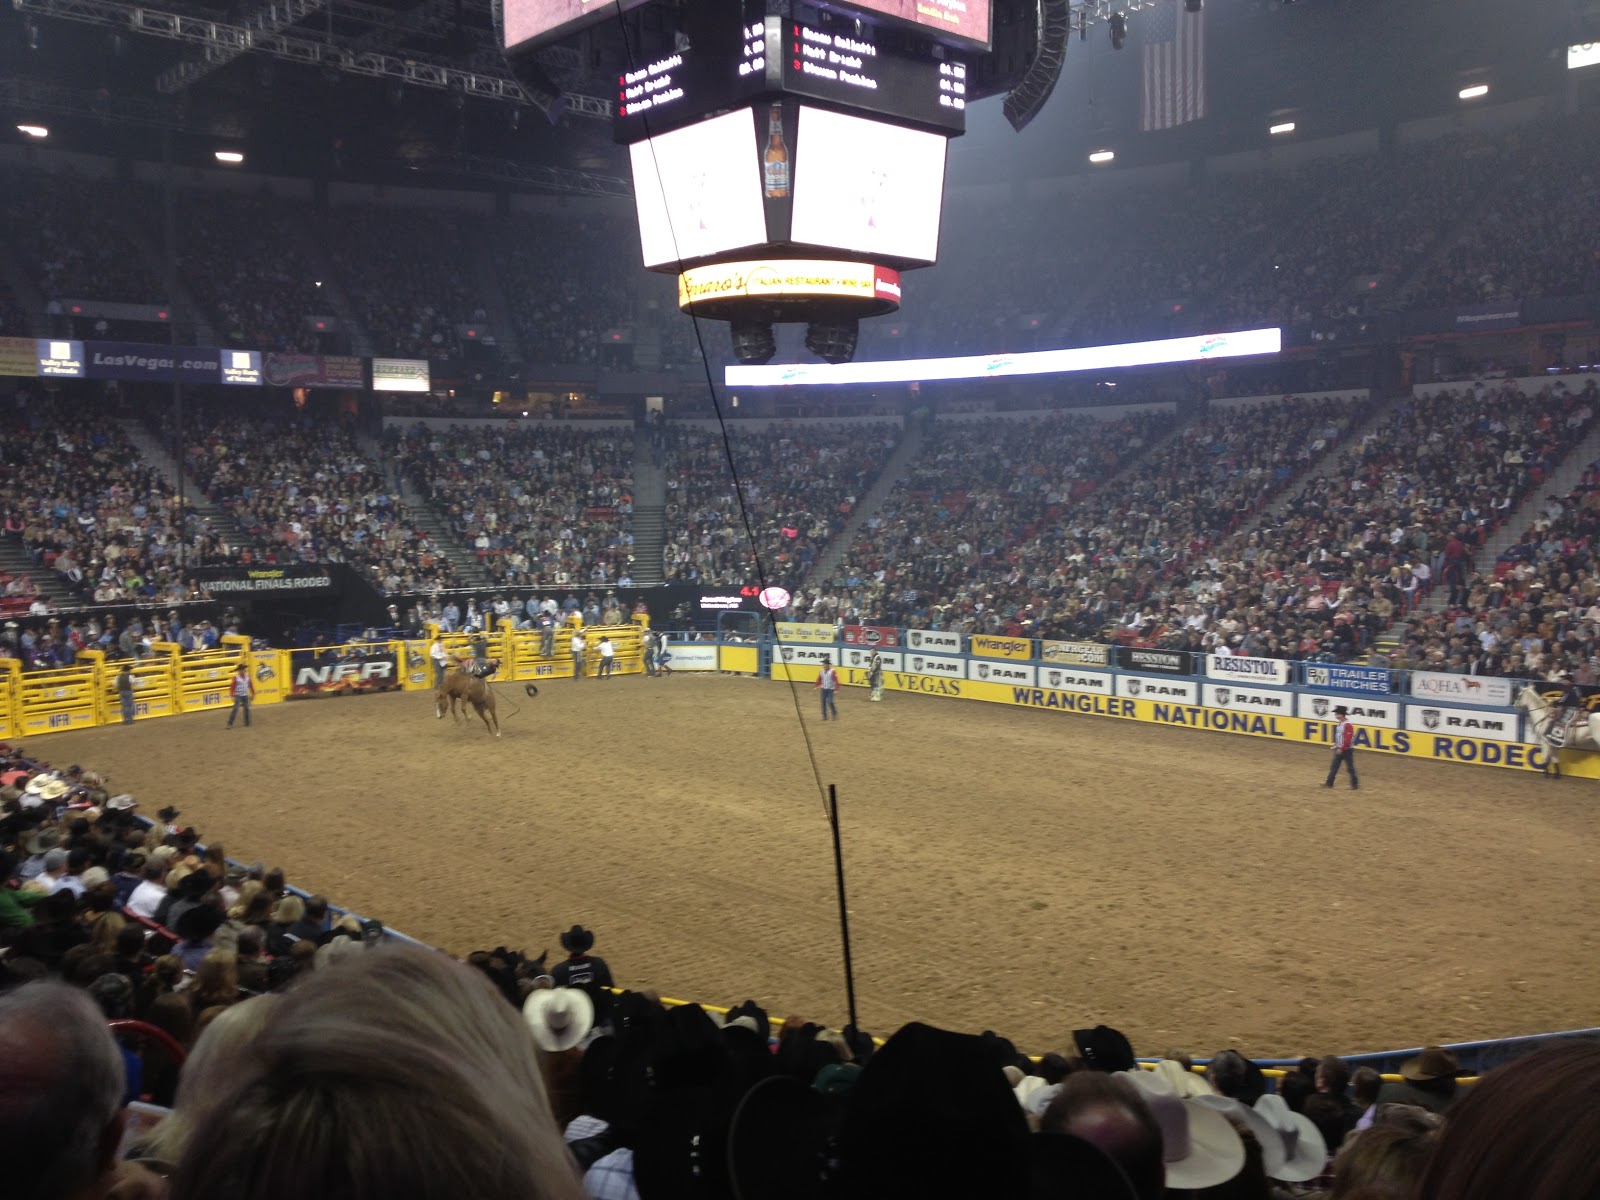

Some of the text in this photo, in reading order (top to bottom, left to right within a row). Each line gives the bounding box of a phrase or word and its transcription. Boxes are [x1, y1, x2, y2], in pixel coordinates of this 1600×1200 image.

[200, 576, 330, 592] NATIONAL FINALS RODEO
[740, 586, 760, 596] 4.1
[924, 636, 957, 647] RAM
[975, 636, 1028, 656] Wrangler
[797, 651, 831, 659] RAM
[864, 656, 895, 665] RM
[1131, 651, 1182, 666] HESSTON
[536, 665, 553, 676] NFR
[926, 662, 958, 672] RAM
[1213, 656, 1277, 676] RESISTOL
[296, 661, 393, 686] NFR
[993, 669, 1027, 679] RAM
[1330, 668, 1389, 681] TRAILER
[894, 674, 961, 695] VEGAS
[1065, 676, 1103, 687] RAM
[1330, 678, 1390, 692] HITCHES
[1417, 678, 1463, 693] AQHA
[1145, 685, 1187, 696] RAM
[203, 692, 221, 706] NFR
[1235, 694, 1282, 707] RAM
[48, 713, 70, 728] NFR
[1012, 687, 1136, 718] WRANGLER
[1153, 703, 1285, 737] NATIONAL
[1303, 721, 1411, 753] FIALS
[1447, 716, 1504, 731] RAM
